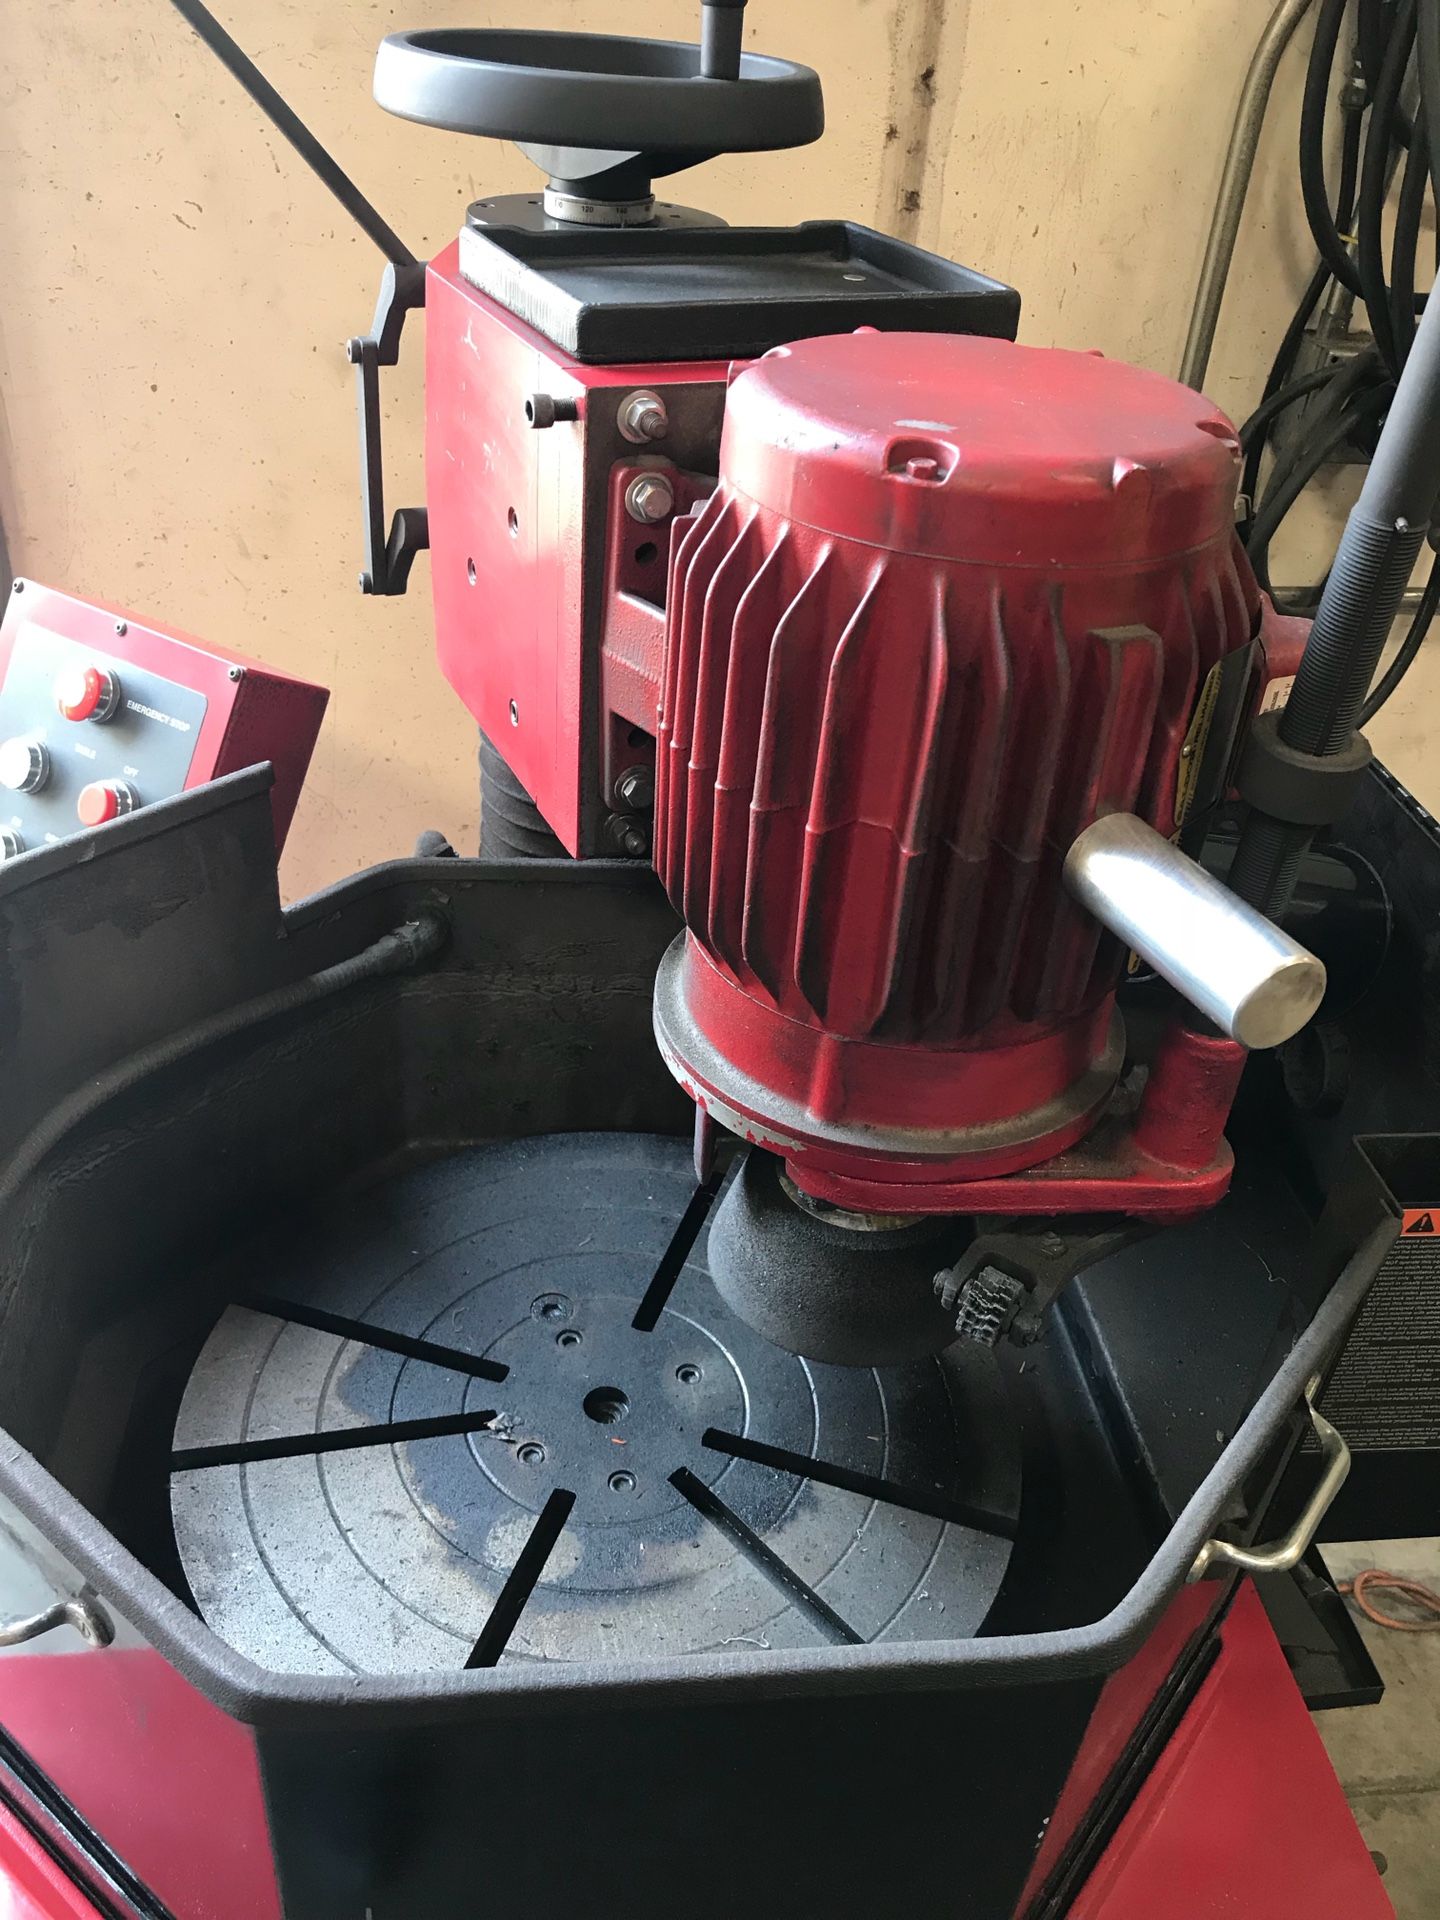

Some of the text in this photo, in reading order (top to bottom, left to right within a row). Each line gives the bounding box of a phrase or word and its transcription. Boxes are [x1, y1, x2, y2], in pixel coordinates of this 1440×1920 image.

[126, 699, 191, 733] EMERGENCY STOP
[123, 765, 140, 778] OFF
